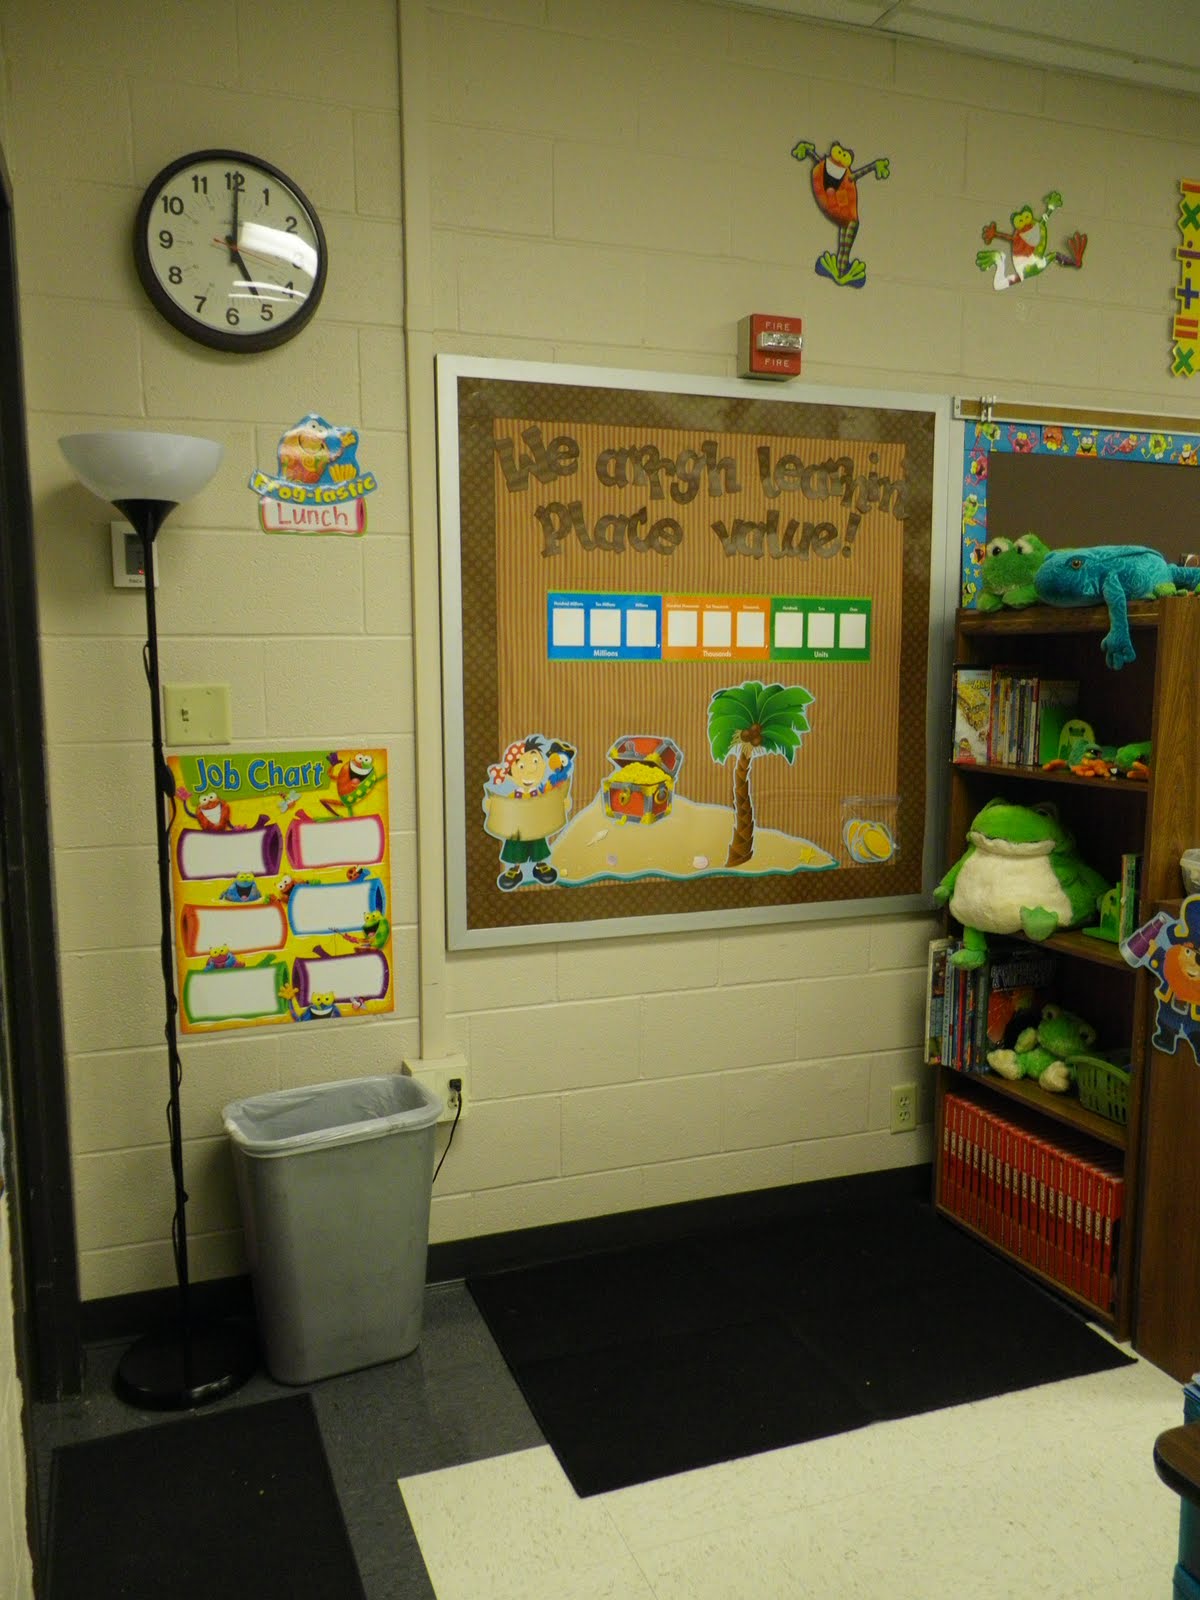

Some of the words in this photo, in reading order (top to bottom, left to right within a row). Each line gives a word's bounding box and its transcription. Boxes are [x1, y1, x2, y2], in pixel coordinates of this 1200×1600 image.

[192, 175, 208, 194] 11
[224, 172, 245, 192] 12
[161, 196, 184, 215] 10
[262, 188, 270, 206] 1
[285, 216, 298, 234] 2
[159, 230, 174, 249] 9
[168, 266, 183, 285] 8
[281, 281, 294, 298] 4
[193, 295, 207, 313] 7
[260, 304, 274, 321] 5
[226, 307, 240, 326] 6
[765, 321, 790, 331] FIRE
[764, 358, 790, 368] FIRE
[495, 425, 579, 492] We
[277, 503, 348, 527] Lunch
[593, 649, 619, 658] Millions
[703, 650, 732, 658] Thousands
[194, 758, 241, 792] Job
[248, 757, 324, 792] Chart
